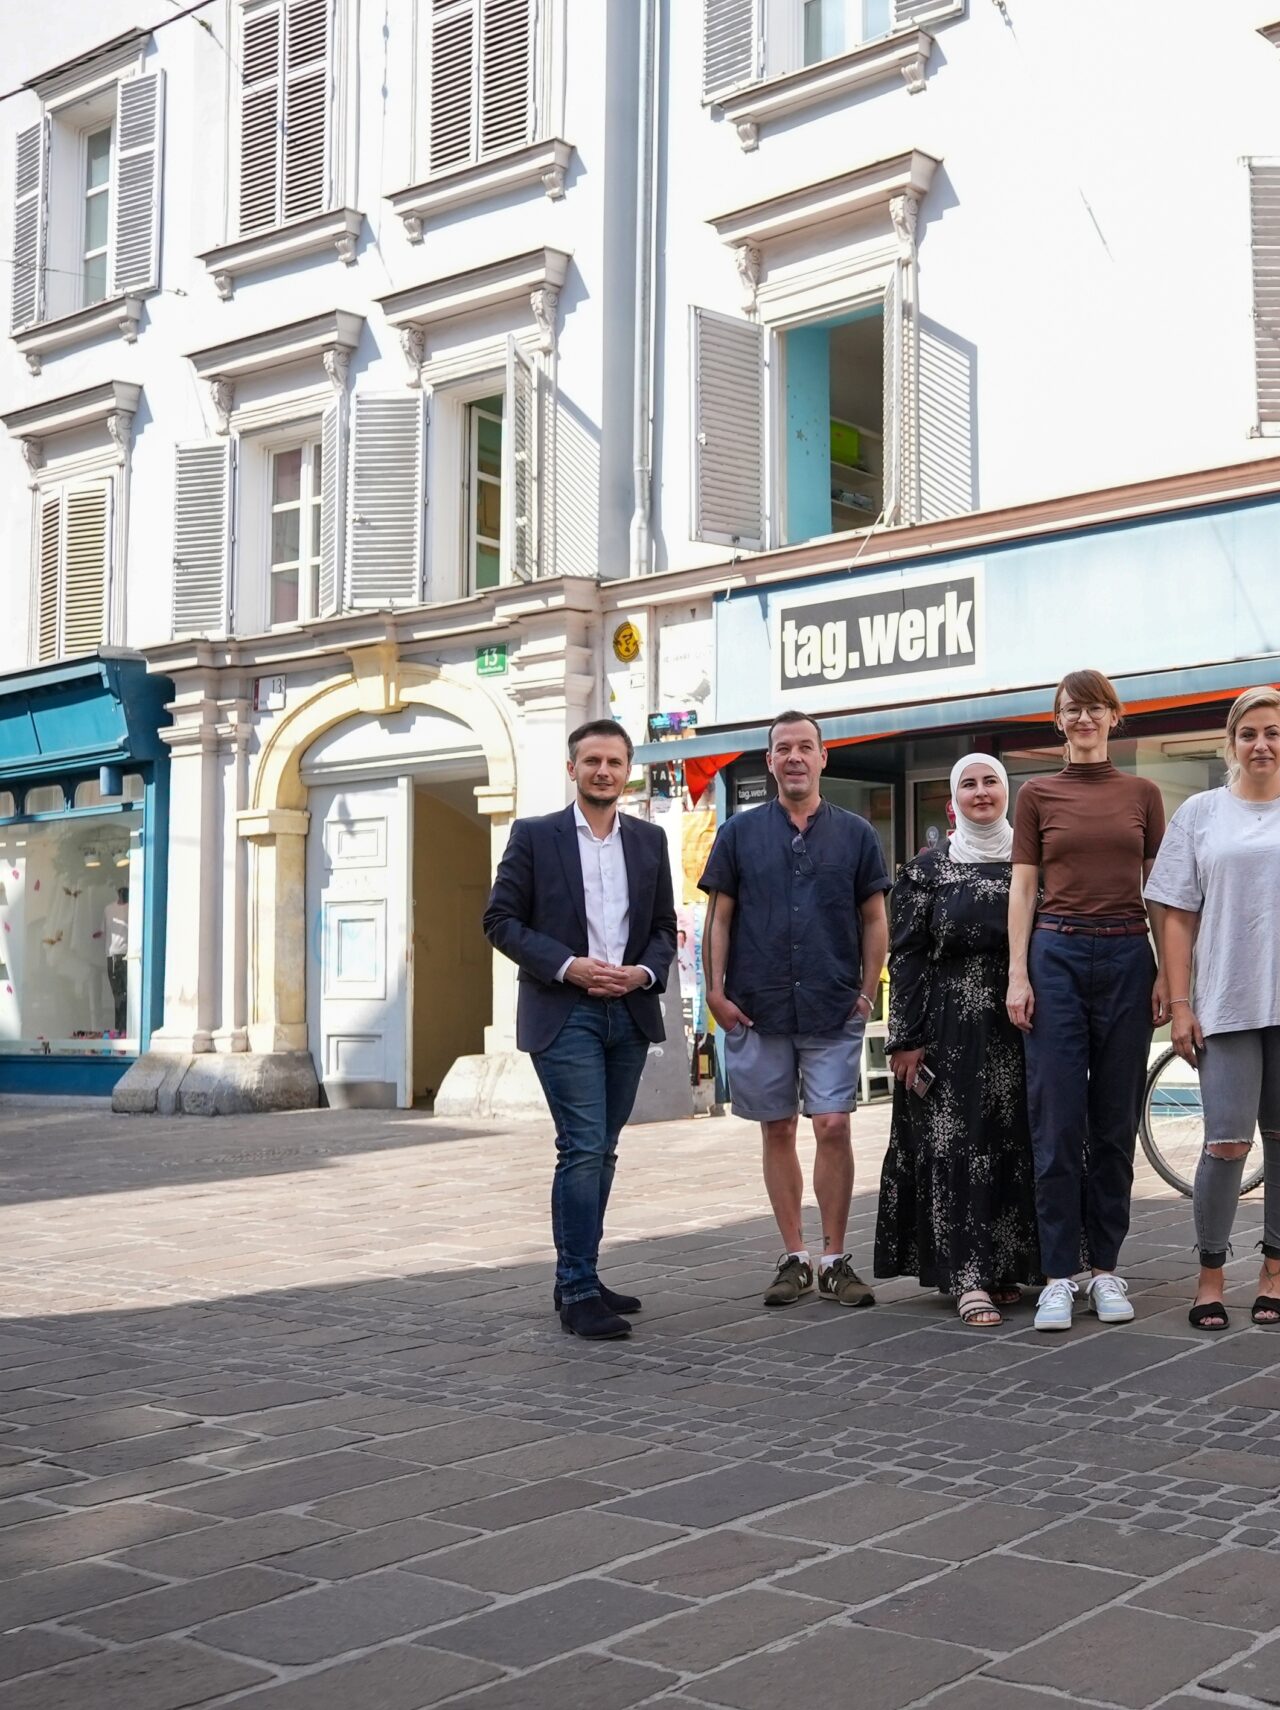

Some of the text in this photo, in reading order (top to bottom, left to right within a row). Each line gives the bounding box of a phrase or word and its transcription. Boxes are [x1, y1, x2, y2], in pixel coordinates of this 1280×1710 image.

[782, 591, 974, 681] tag.werk
[483, 648, 498, 666] 13
[272, 678, 282, 693] 13
[738, 787, 767, 800] tag.werk
